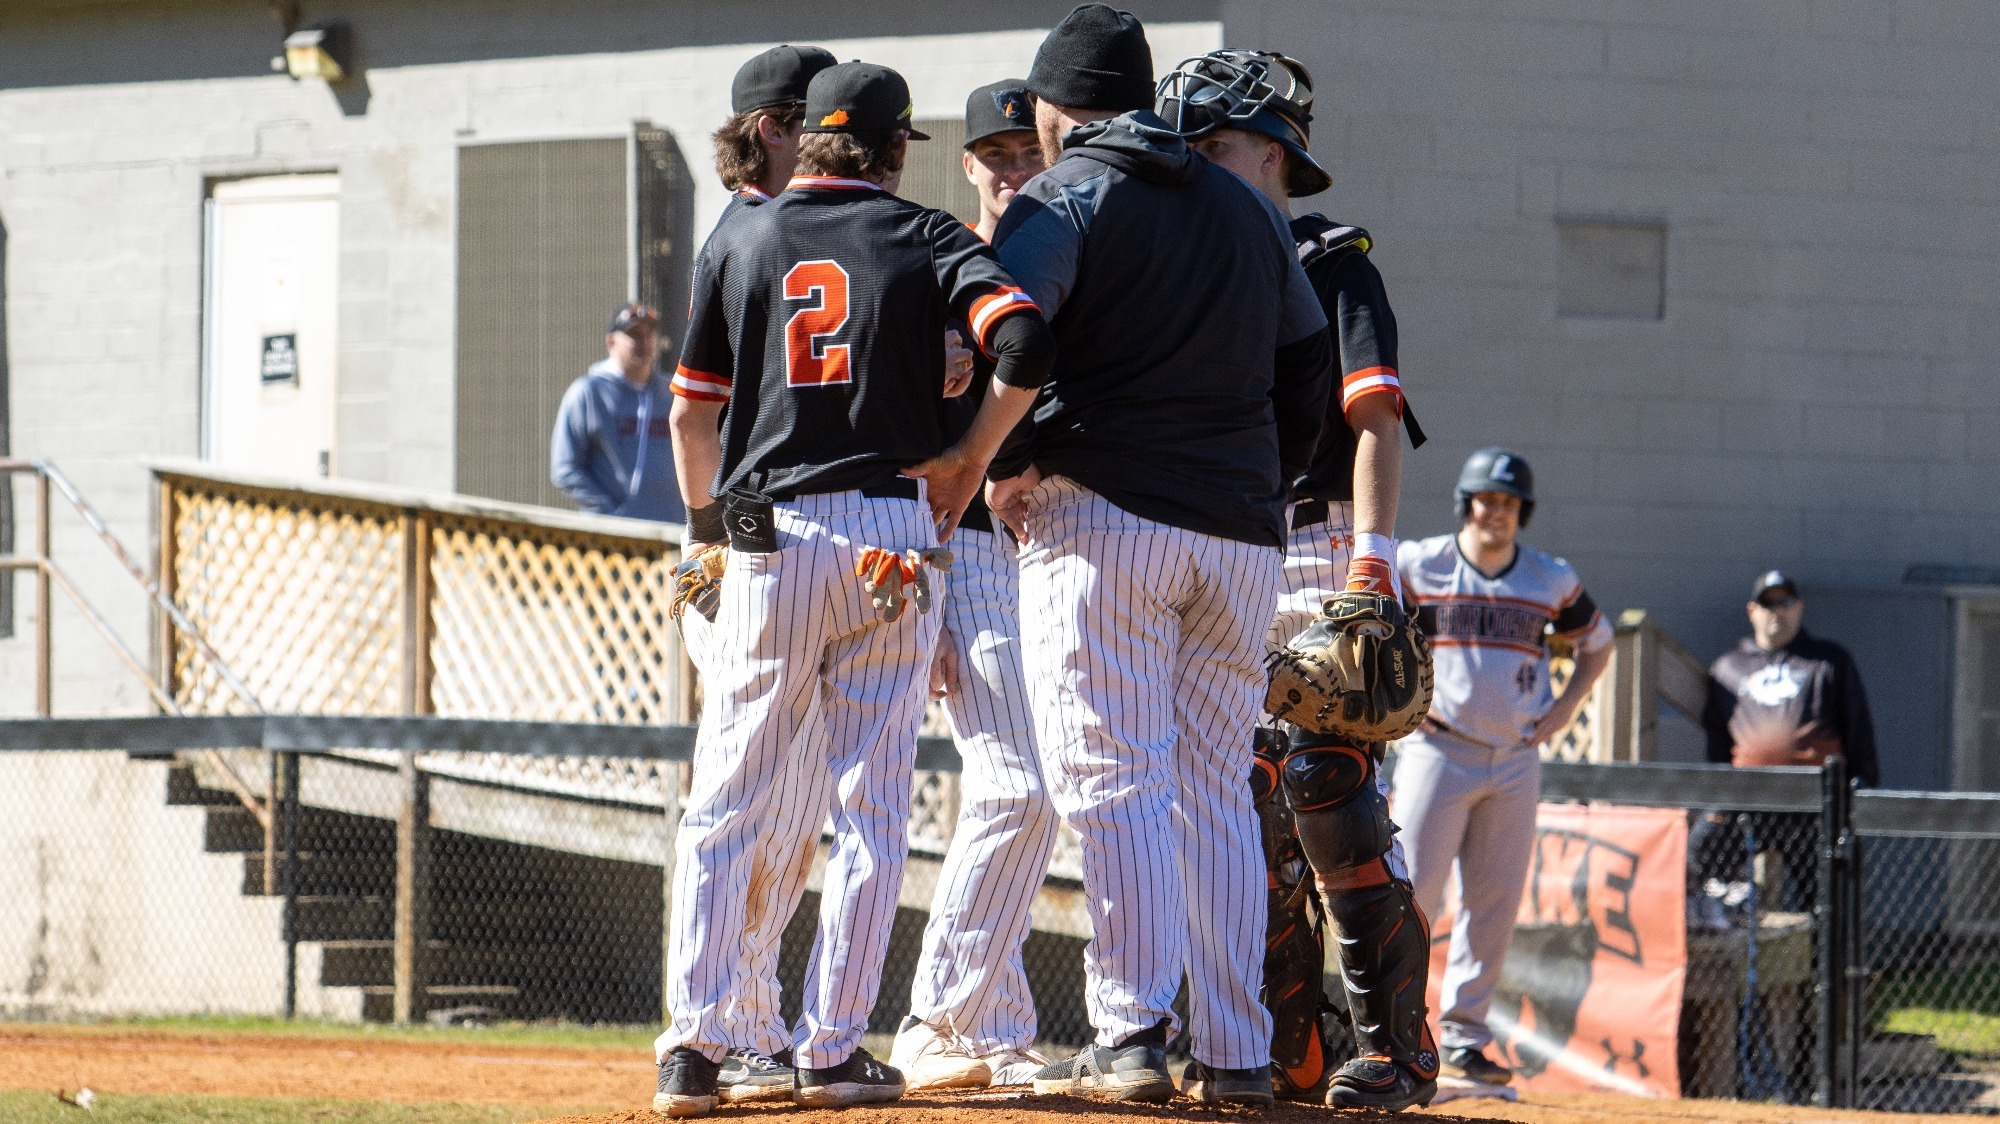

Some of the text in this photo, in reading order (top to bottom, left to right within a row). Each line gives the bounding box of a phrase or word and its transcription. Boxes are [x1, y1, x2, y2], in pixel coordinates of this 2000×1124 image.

[783, 259, 852, 388] 2
[1393, 649, 1406, 689] ALL-STAR
[1520, 828, 1641, 963] KE
